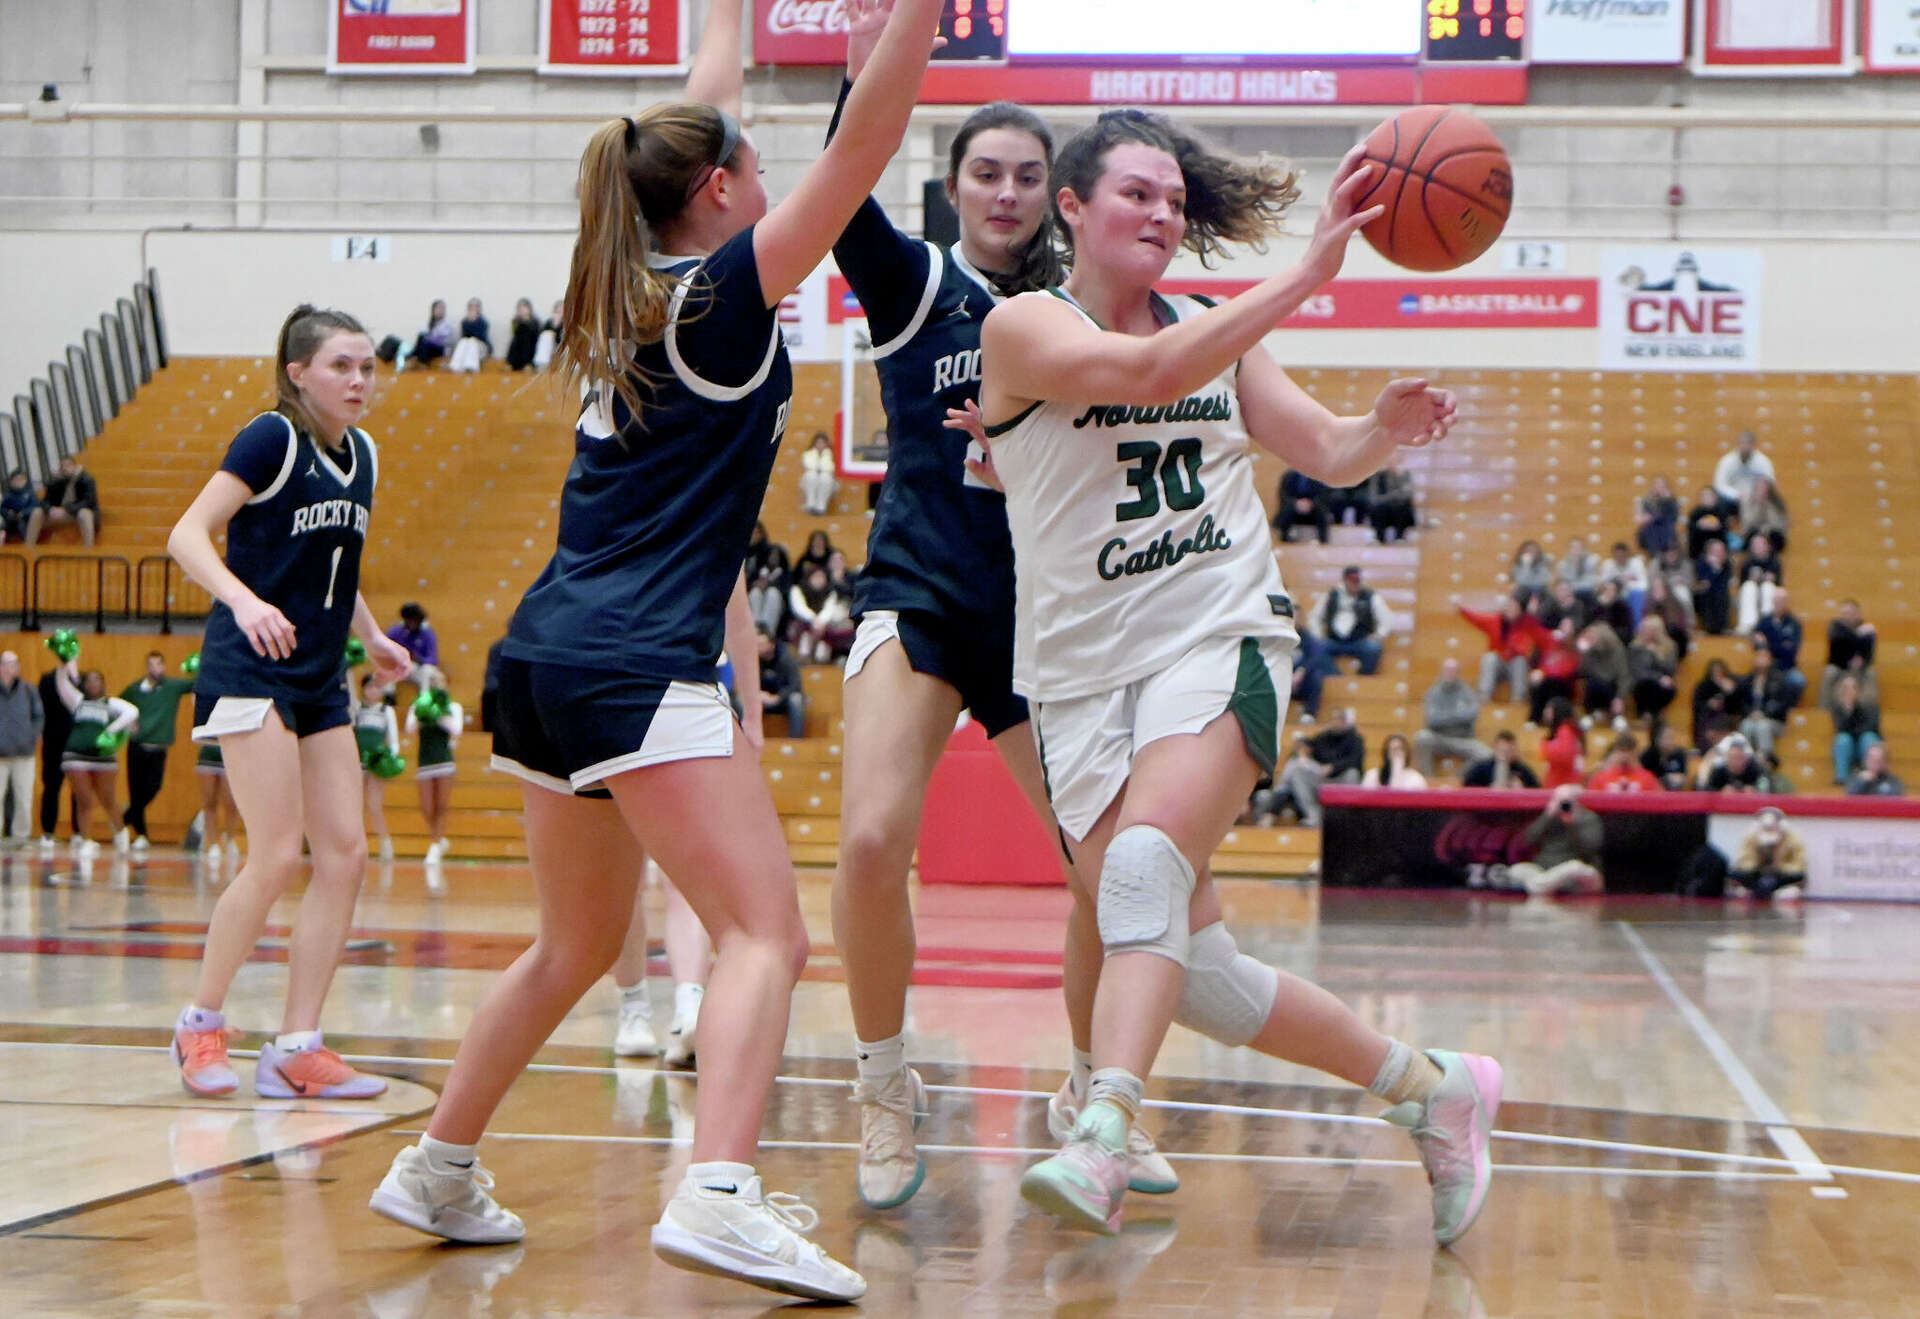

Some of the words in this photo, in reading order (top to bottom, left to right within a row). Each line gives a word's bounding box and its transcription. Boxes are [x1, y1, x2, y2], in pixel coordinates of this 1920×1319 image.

[1091, 71, 1235, 101] HARTFORD
[1240, 71, 1337, 101] HAWKS
[1420, 295, 1562, 315] BASKETBALL
[1626, 297, 1744, 334] CNE
[933, 349, 982, 393] ROC
[1116, 437, 1205, 522] 30
[290, 499, 353, 538] ROCKY
[1097, 514, 1231, 580] Catholic
[323, 545, 344, 610] 1
